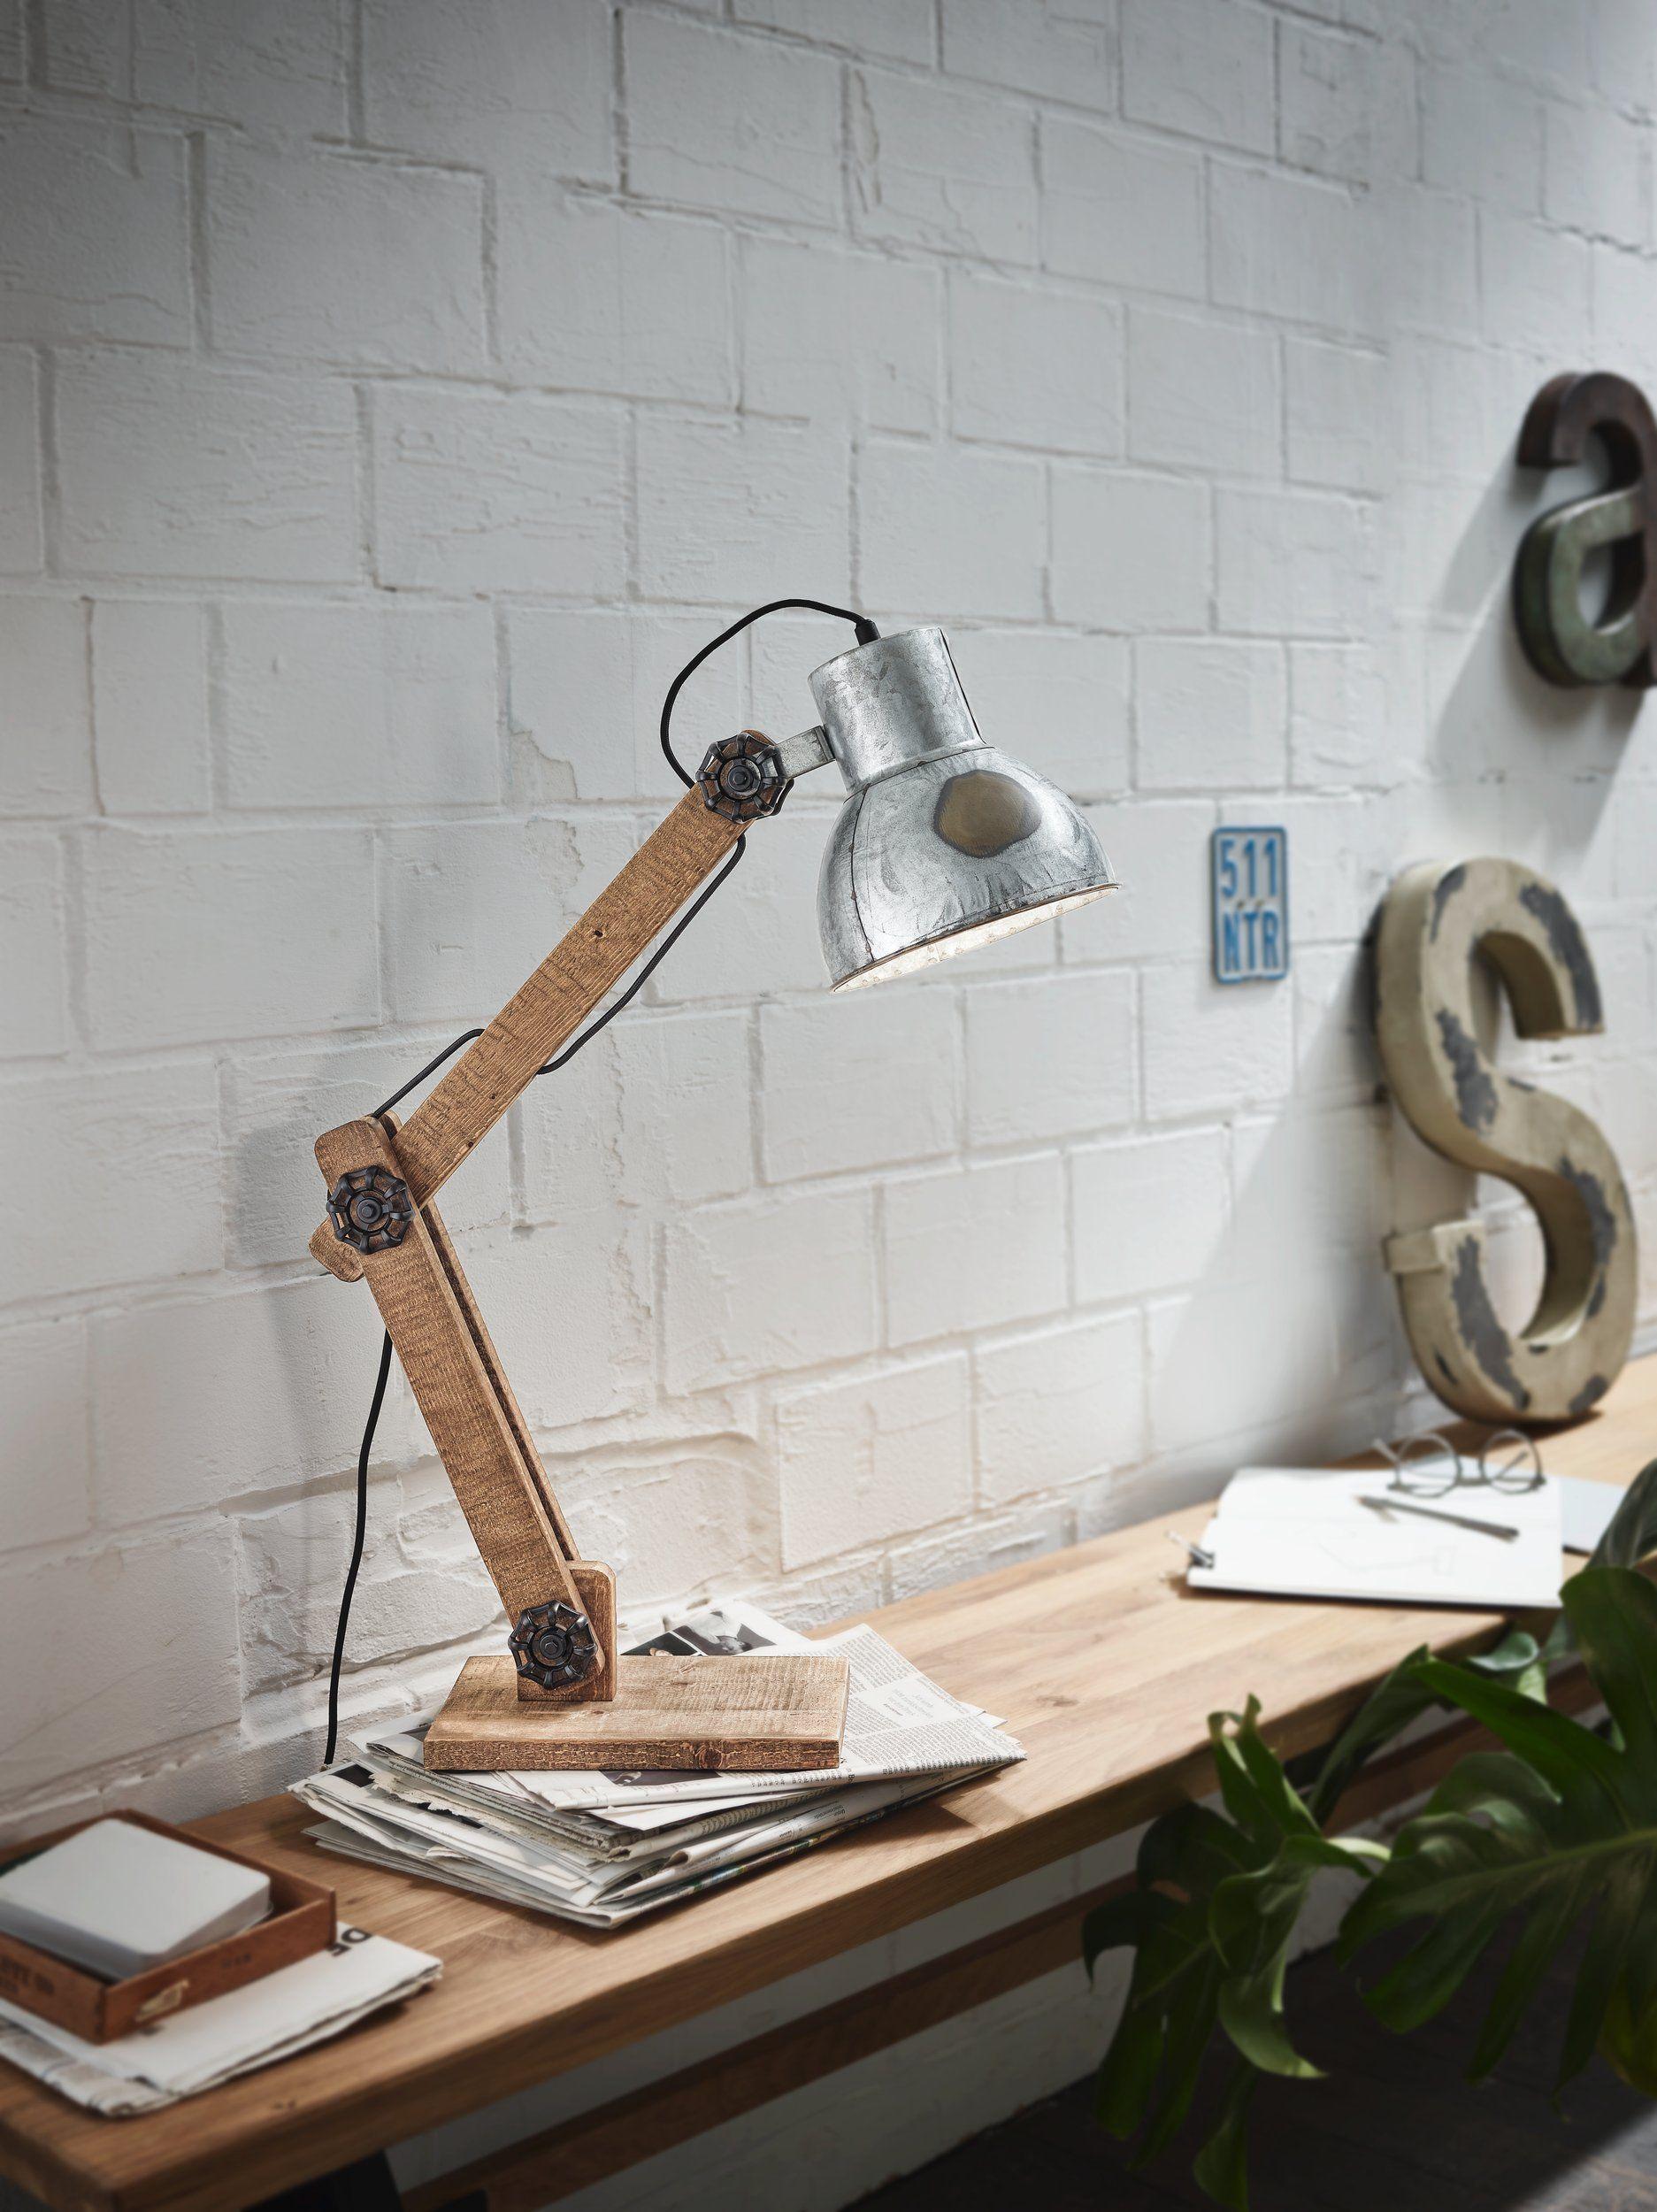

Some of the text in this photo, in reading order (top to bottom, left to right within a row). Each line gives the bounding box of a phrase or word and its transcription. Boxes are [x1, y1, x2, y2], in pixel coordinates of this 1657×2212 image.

[1220, 838, 1277, 898] 511
[1223, 910, 1279, 972] NTR
[1377, 856, 1638, 1421] S
